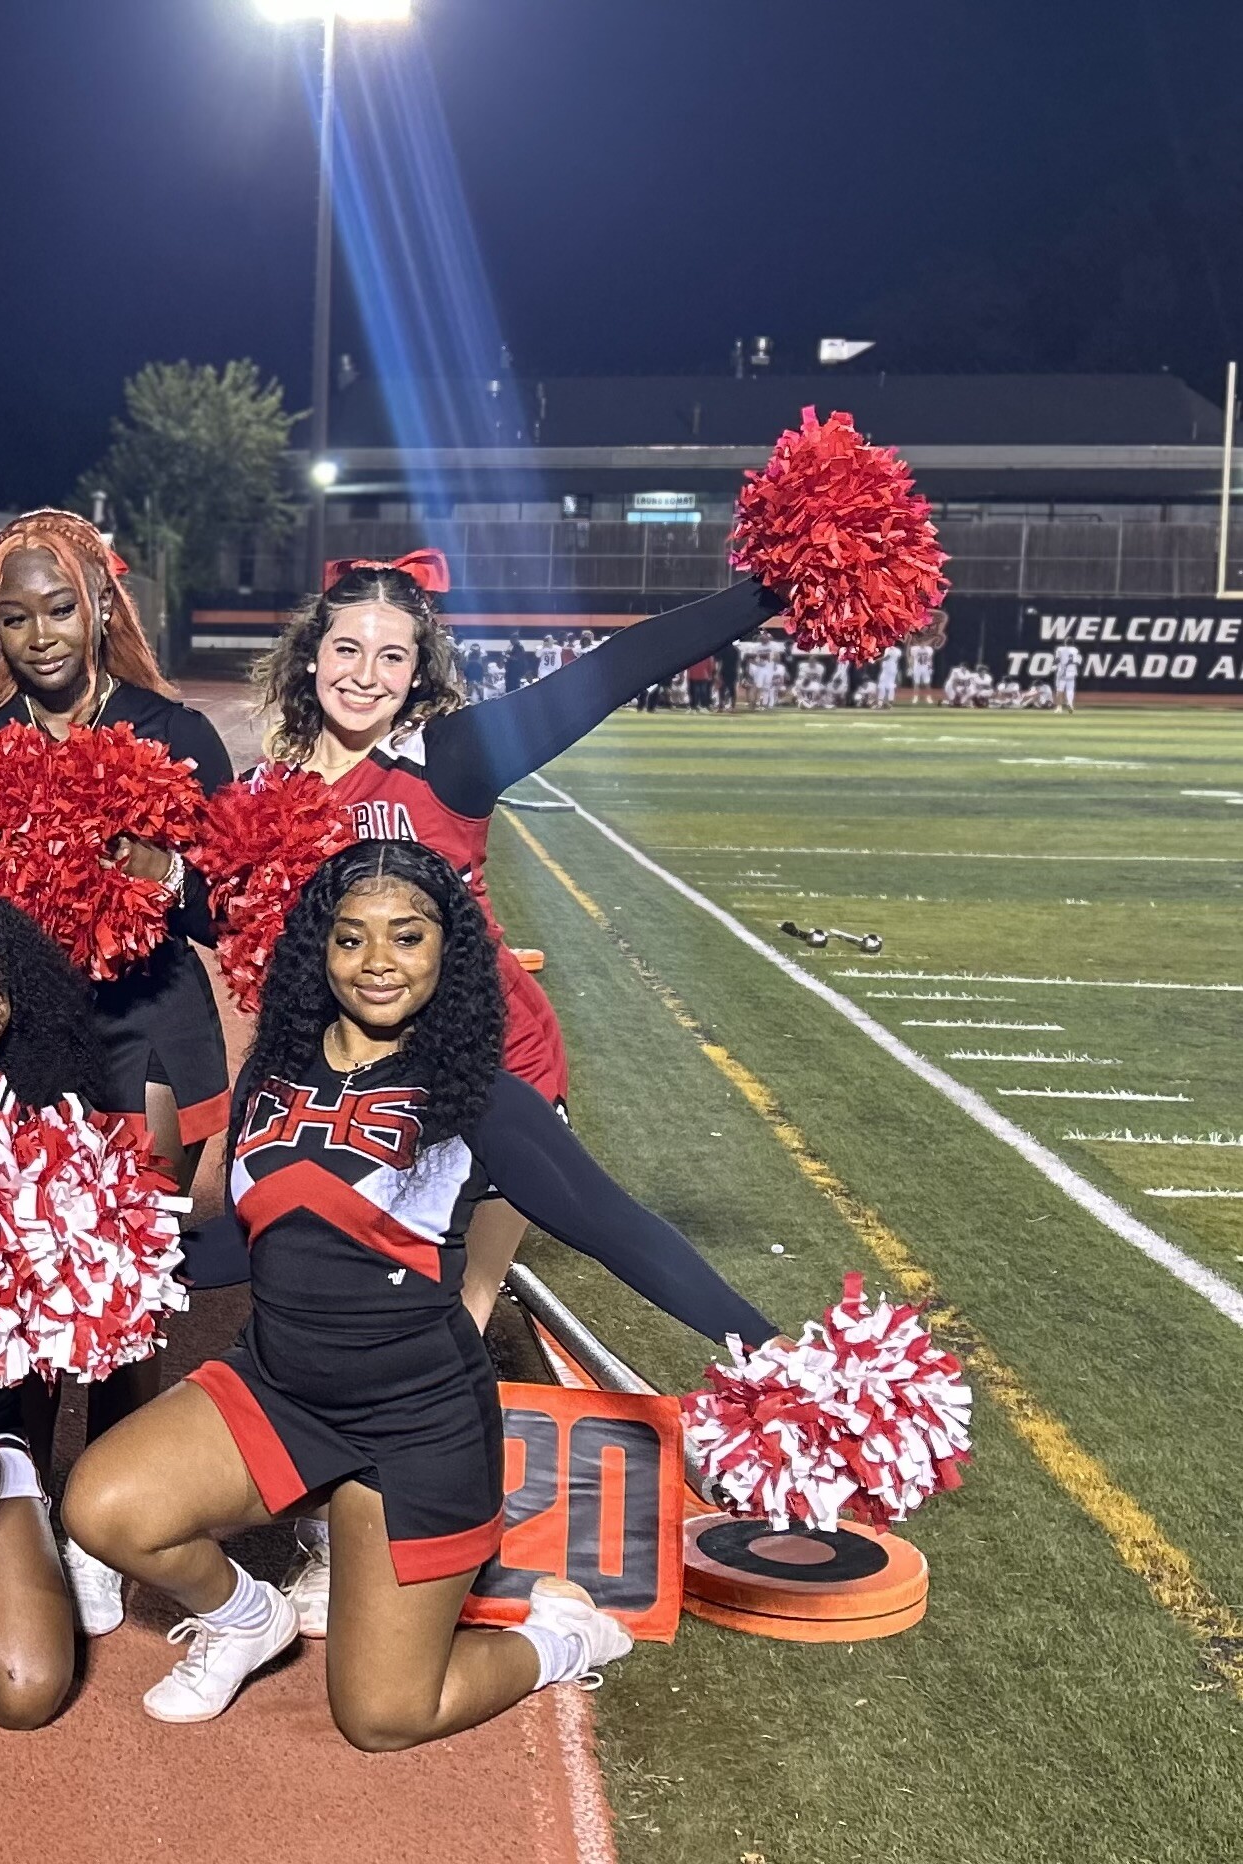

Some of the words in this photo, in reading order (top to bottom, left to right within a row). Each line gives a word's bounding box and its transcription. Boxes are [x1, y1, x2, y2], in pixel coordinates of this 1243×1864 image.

[1039, 615, 1242, 643] WELCOME
[1007, 652, 1198, 679] TONADO
[1207, 655, 1243, 680] A
[339, 800, 419, 842] BIA
[234, 1075, 431, 1172] CHS
